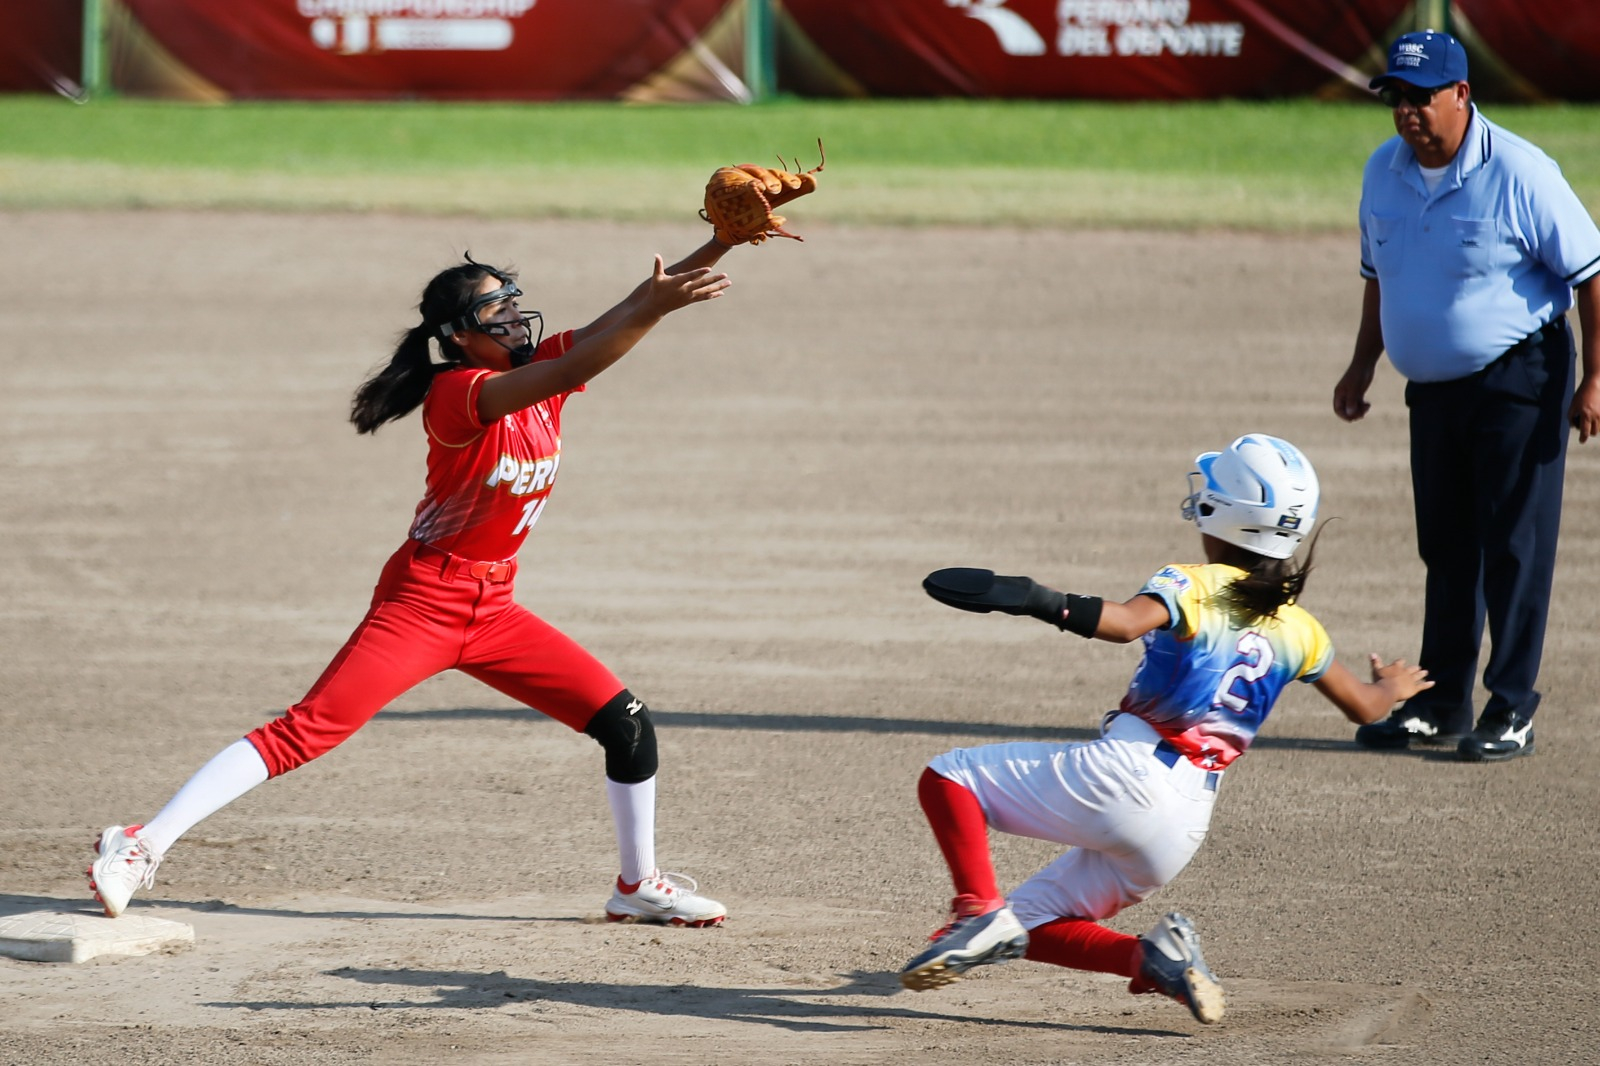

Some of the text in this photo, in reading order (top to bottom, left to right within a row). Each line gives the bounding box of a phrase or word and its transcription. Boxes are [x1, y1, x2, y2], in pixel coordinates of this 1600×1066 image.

[1056, 22, 1244, 56] DEL DEPORTE
[1213, 631, 1275, 714] 2
